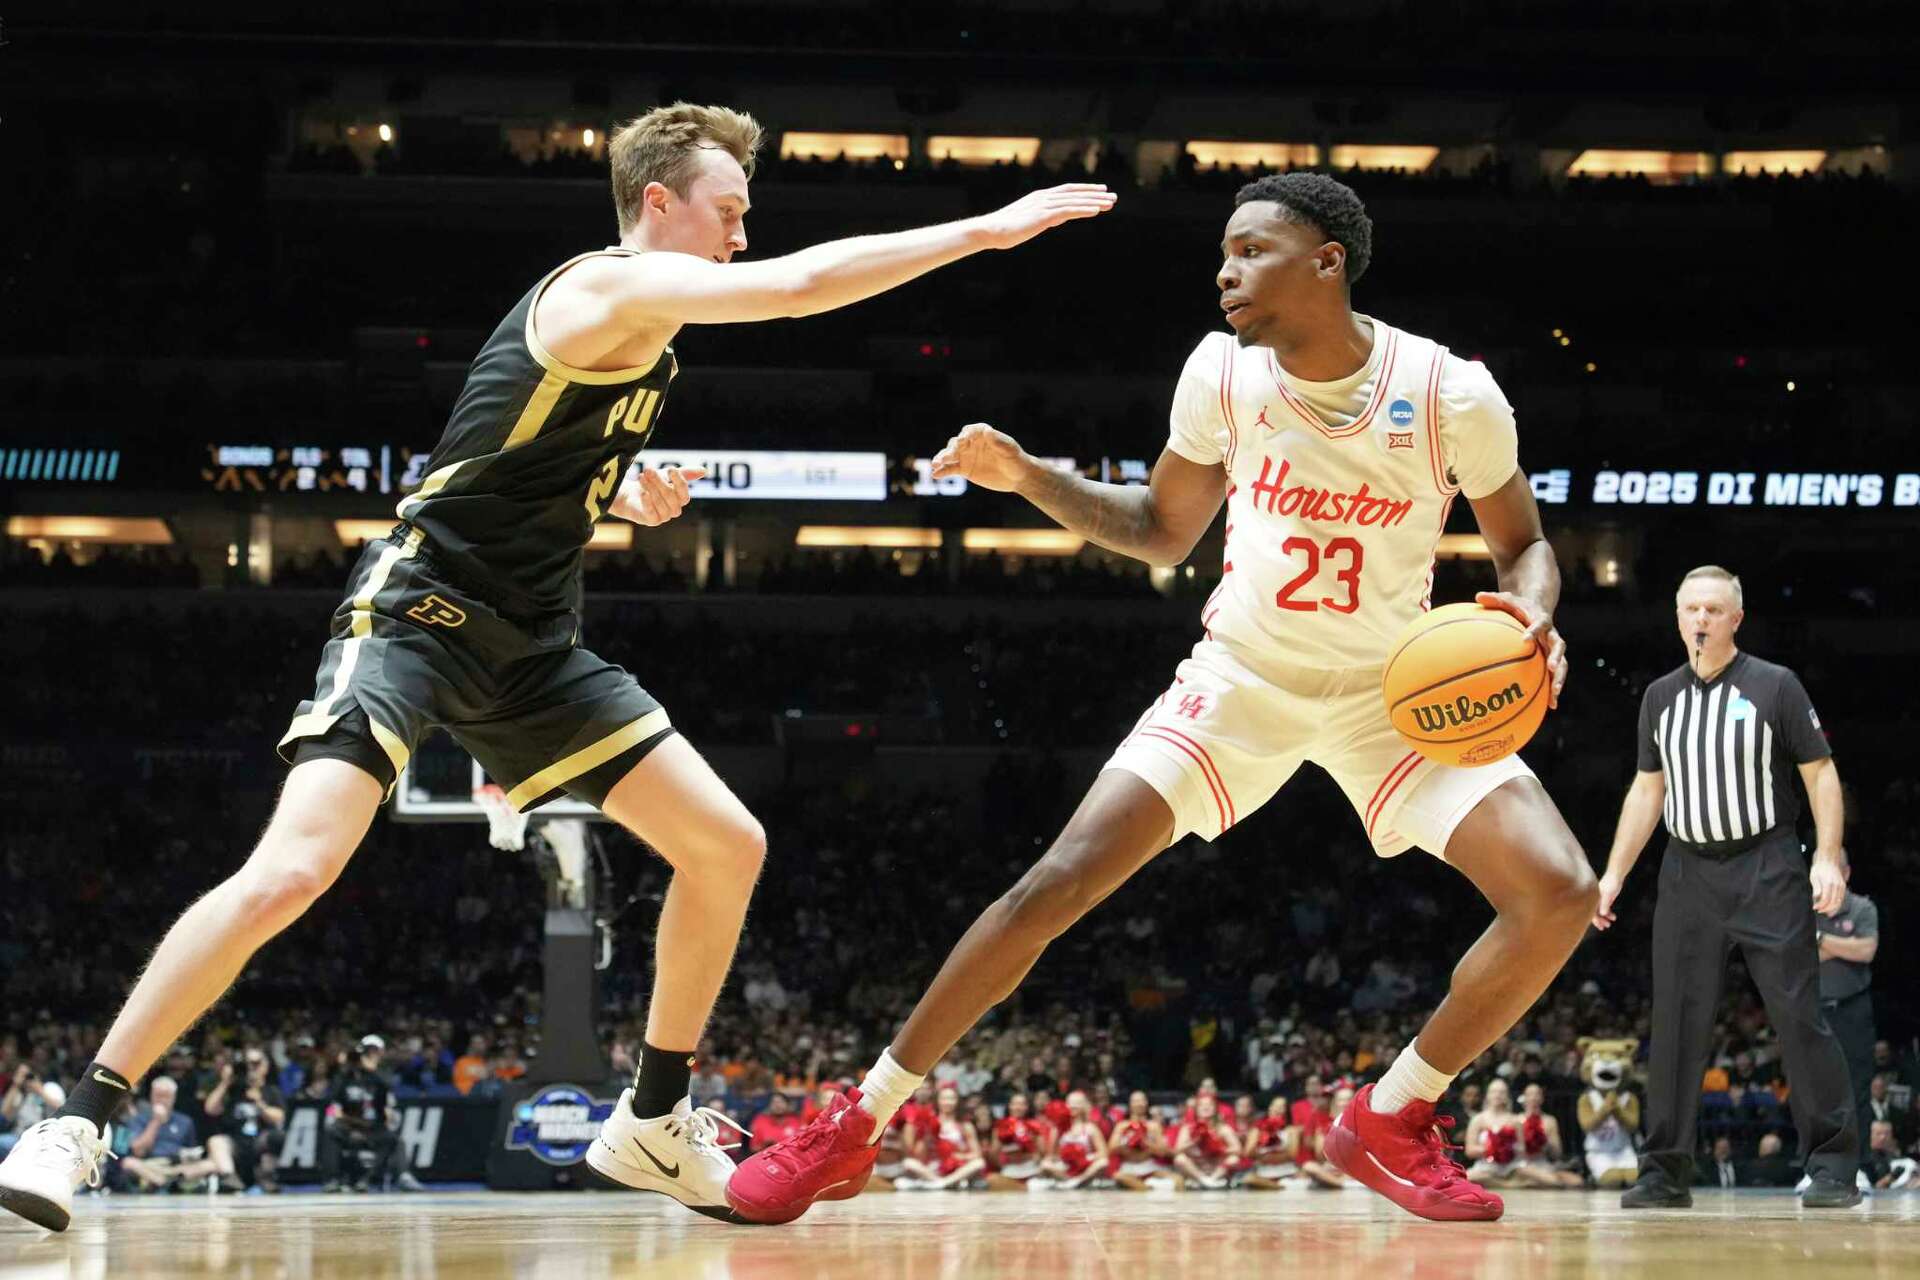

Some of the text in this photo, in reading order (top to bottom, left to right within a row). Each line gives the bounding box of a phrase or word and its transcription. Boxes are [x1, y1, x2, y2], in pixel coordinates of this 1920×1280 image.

[584, 455, 619, 524] 2
[1250, 455, 1413, 529] Houston
[1592, 471, 1699, 504] 2025
[1707, 472, 1756, 505] DI
[1764, 473, 1884, 506] MEN'S
[1276, 536, 1364, 614] 23
[1411, 682, 1525, 733] Wilson
